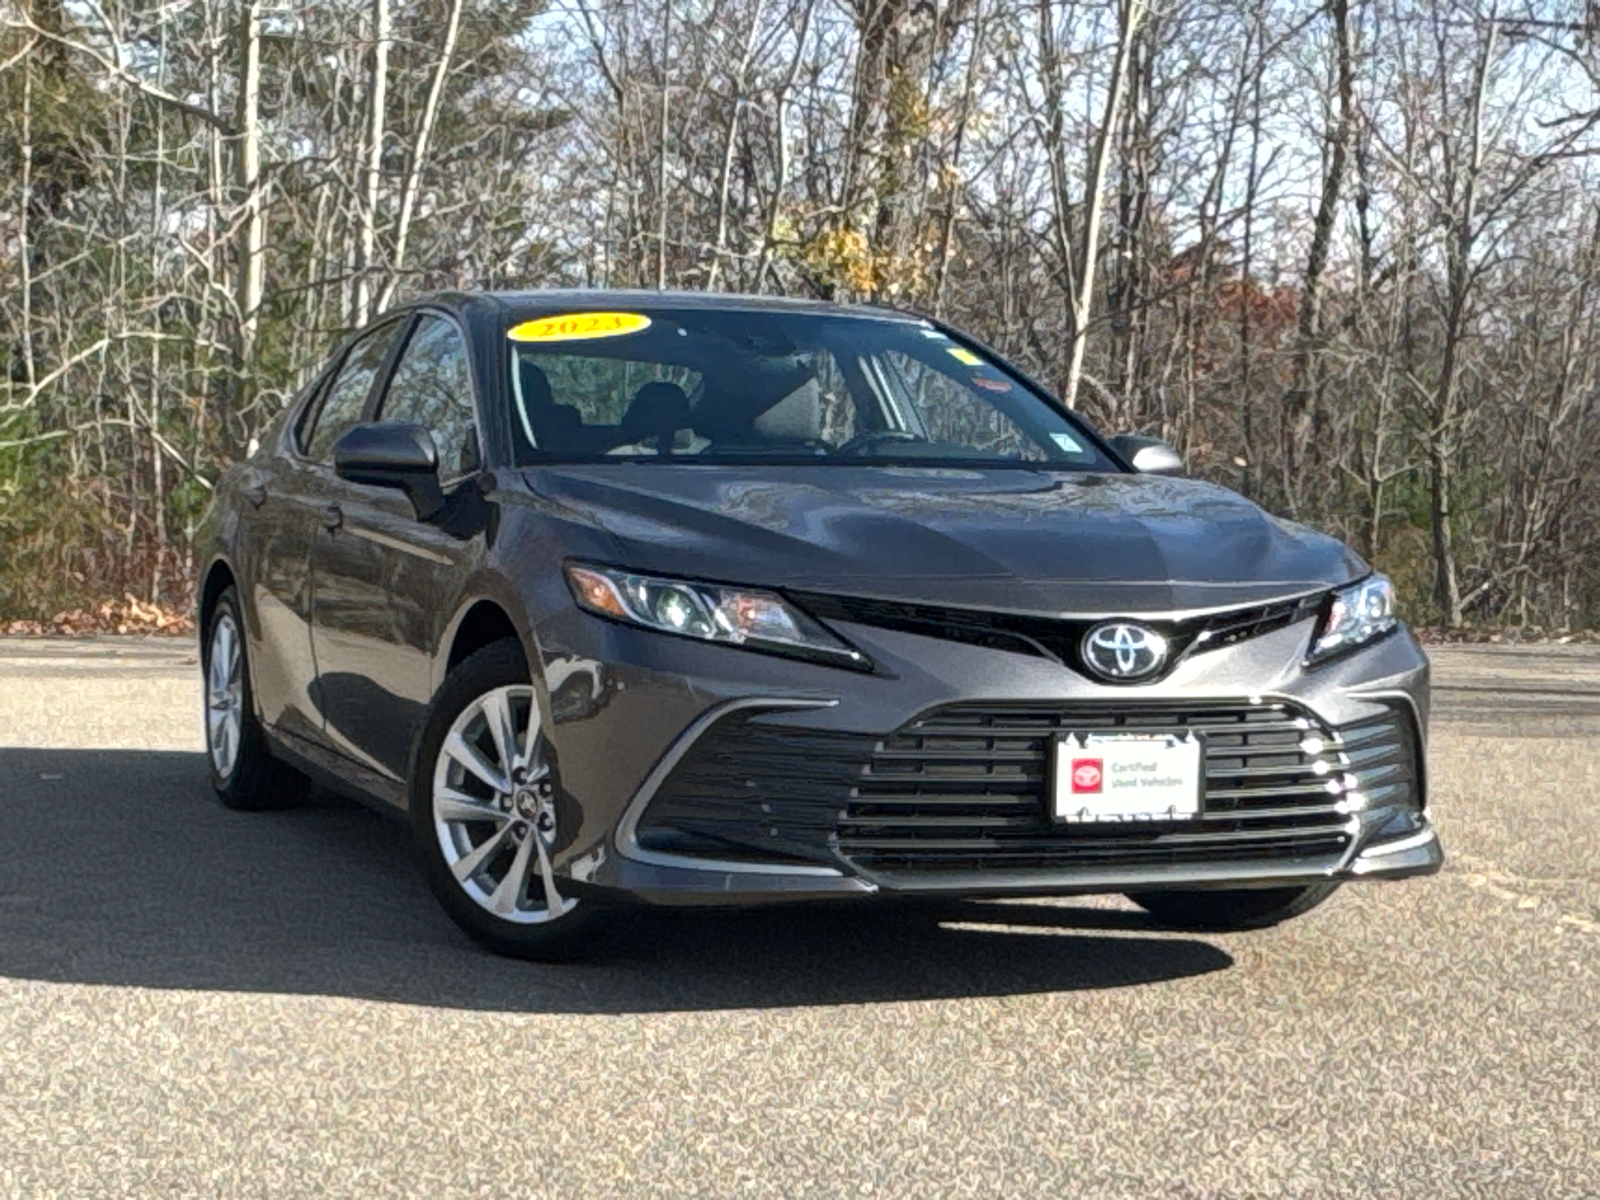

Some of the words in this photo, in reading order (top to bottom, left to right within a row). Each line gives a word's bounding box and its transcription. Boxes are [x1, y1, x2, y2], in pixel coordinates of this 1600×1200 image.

[538, 316, 622, 337] 2023
[1111, 762, 1158, 773] Certified
[1112, 777, 1138, 788] Used
[1140, 776, 1183, 788] Vehicles
